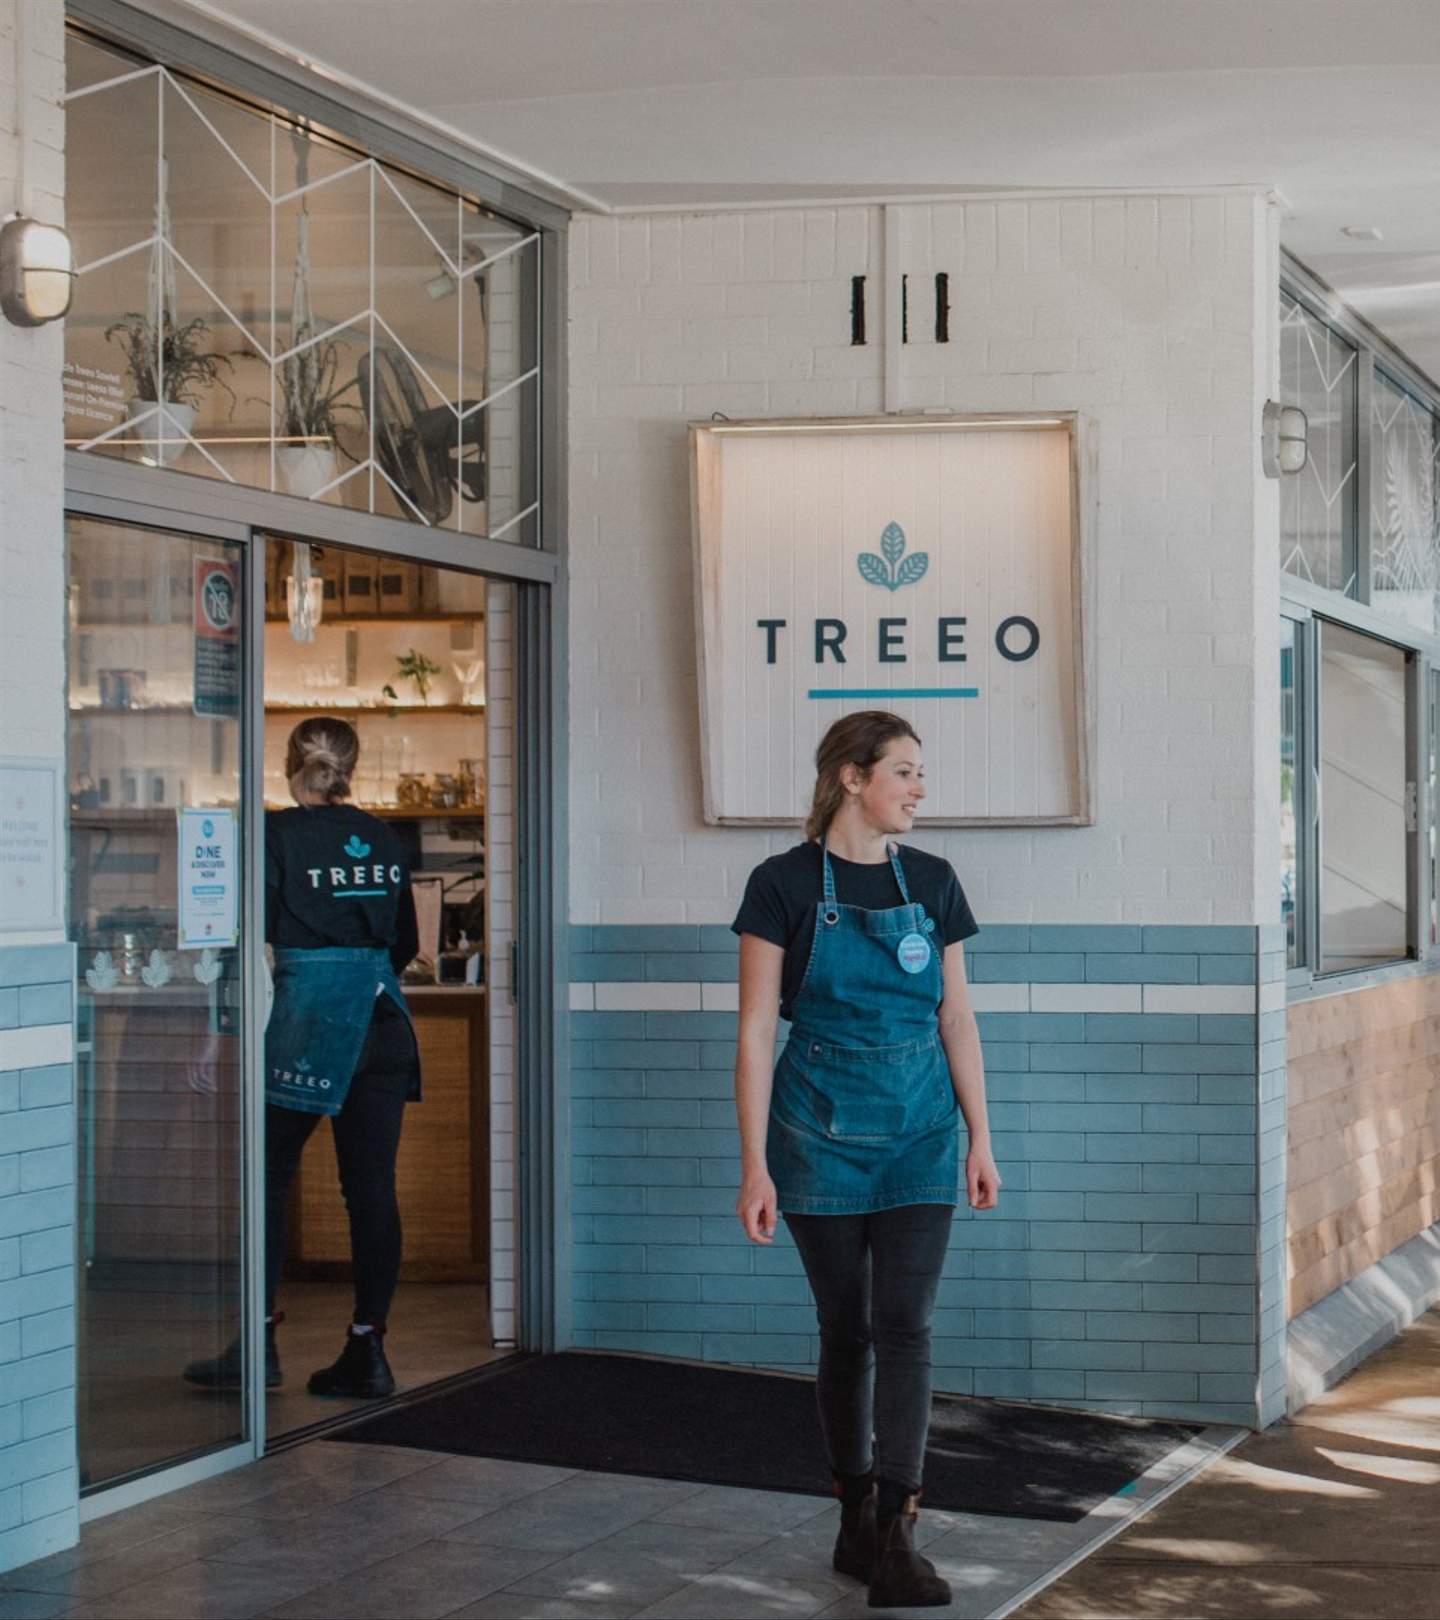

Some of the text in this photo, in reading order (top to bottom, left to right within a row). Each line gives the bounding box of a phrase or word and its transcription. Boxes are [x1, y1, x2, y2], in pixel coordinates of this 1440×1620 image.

[756, 615, 1041, 665] TREEO
[195, 845, 222, 859] DINE
[273, 1068, 332, 1090] TREEO
